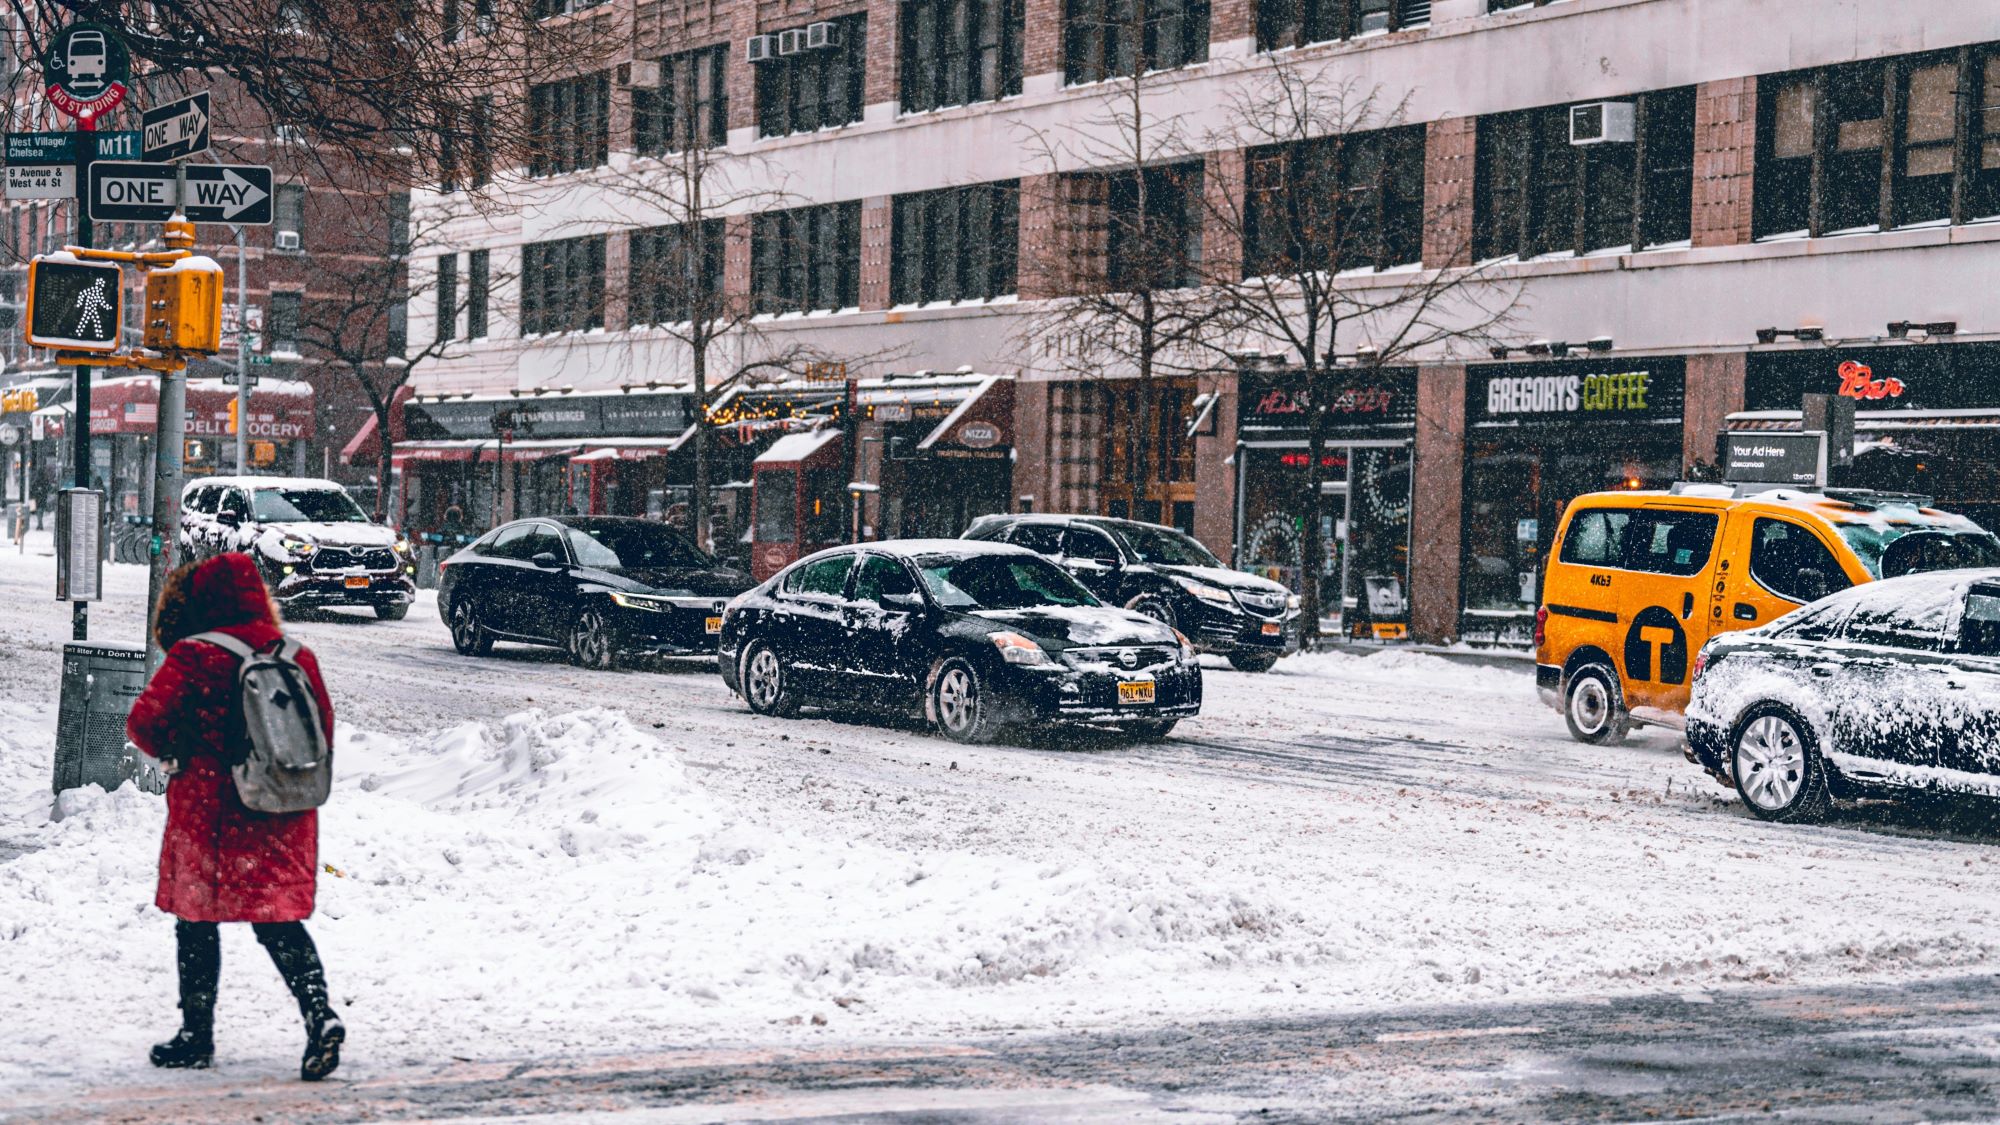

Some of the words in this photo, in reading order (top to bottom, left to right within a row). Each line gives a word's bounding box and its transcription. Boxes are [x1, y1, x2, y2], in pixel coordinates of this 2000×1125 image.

[51, 88, 67, 105] NO
[67, 87, 120, 114] STANDING
[147, 123, 168, 149] ONE
[179, 113, 202, 139] WAY
[9, 137, 31, 147] West
[35, 136, 67, 148] Village/
[99, 135, 131, 155] M11
[9, 147, 43, 157] Chelsea
[9, 168, 15, 178] 9
[20, 168, 51, 177] Avenue
[55, 168, 62, 177] &
[9, 178, 31, 188] West
[35, 178, 47, 188] 44
[51, 178, 61, 188] St
[106, 180, 164, 204] ONE
[196, 183, 252, 206] WAY
[1838, 360, 1906, 400] Bar
[1488, 375, 1580, 413] GREGORYS
[1583, 371, 1649, 411] COFFEE
[556, 410, 585, 422] BURGER
[184, 420, 219, 434] DELI
[225, 420, 302, 436] OCERY
[965, 429, 993, 440] NIZZA
[1733, 445, 1751, 457] Your
[1752, 445, 1765, 457] Ad
[1765, 446, 1785, 457] Here
[108, 650, 131, 658] Don't
